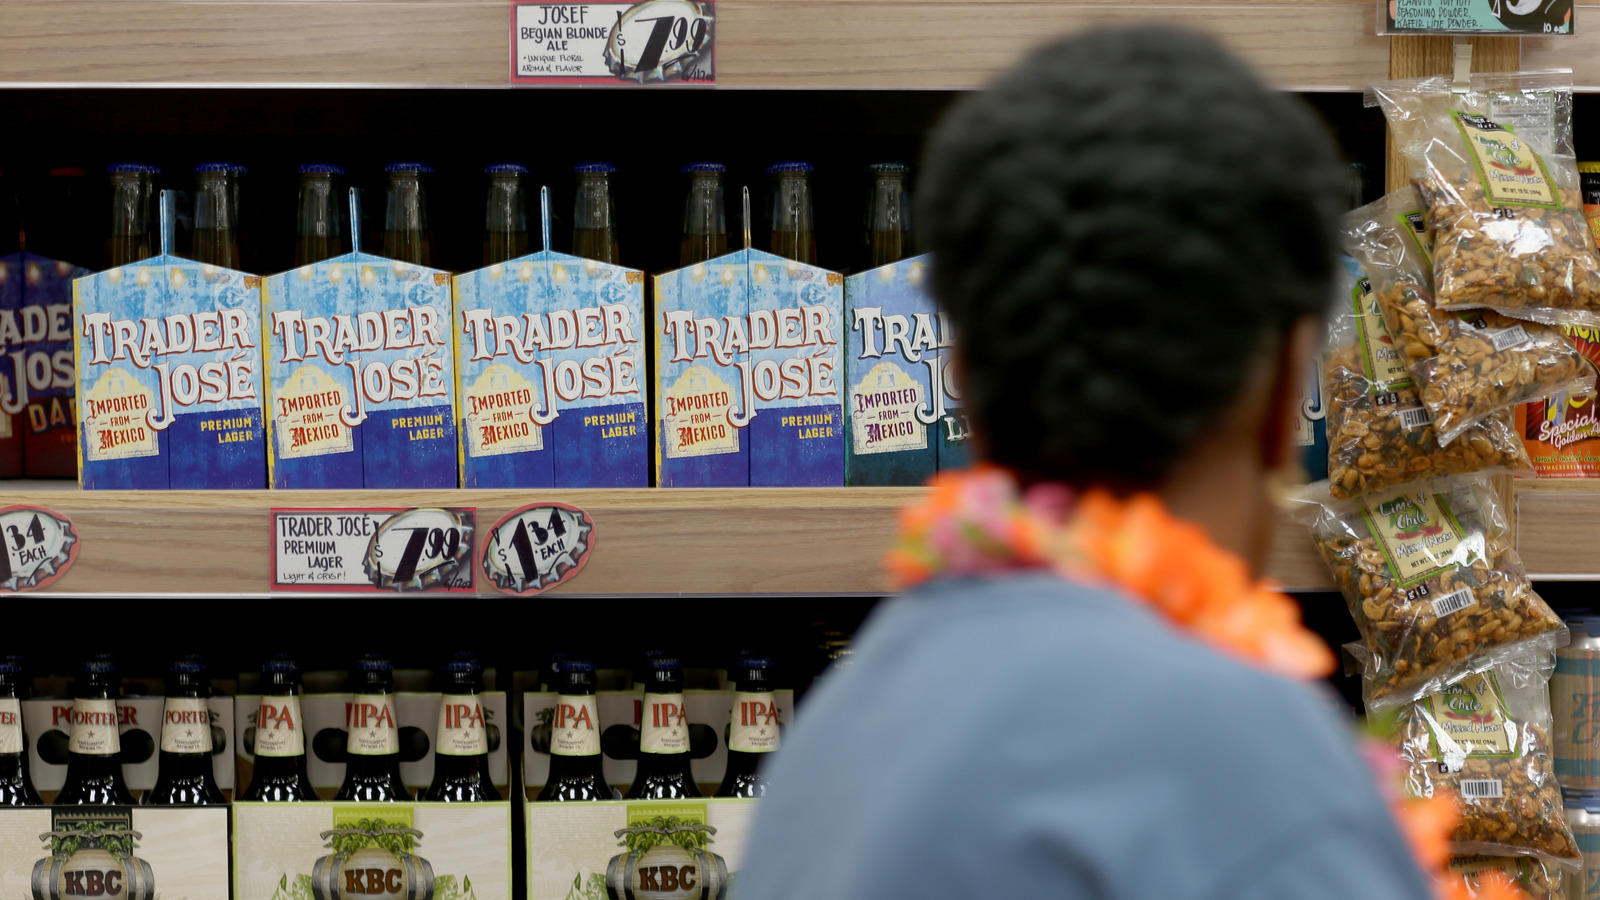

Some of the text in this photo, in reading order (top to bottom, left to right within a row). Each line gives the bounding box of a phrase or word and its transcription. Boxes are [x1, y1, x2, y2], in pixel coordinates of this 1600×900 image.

[538, 6, 589, 25] JOSEF
[1396, 7, 1435, 19] SEASONING
[566, 27, 608, 40] BLONDE
[1542, 23, 1552, 33] 10
[547, 41, 568, 51] ALE
[1476, 134, 1507, 151] Lime
[0, 303, 73, 355] ADE
[82, 308, 256, 369] TRADER
[271, 305, 447, 366] TRADER
[462, 303, 640, 365] TRADER
[663, 305, 838, 367] TRADER
[852, 305, 957, 363] TRA
[1, 349, 75, 416] JOS
[145, 350, 257, 432] JOSÉ
[339, 347, 448, 428] JOSÉ
[529, 345, 640, 426] JOSÉ
[727, 346, 838, 430] JOSÉ
[914, 355, 963, 425] JO
[86, 394, 148, 421] IMPORTED
[277, 391, 342, 418] IMPORTED
[467, 389, 532, 416] IMPORTED
[665, 391, 729, 418] IMPORTED
[853, 388, 918, 415] IMPORTED
[29, 397, 77, 432] DA
[110, 415, 132, 428] FROM
[200, 418, 252, 432] PREMIUM
[302, 412, 325, 425] FROM
[391, 415, 444, 430] PREMIUM
[492, 412, 515, 424] FROM
[584, 413, 637, 427] PREMIUM
[691, 413, 712, 425] FROM
[781, 414, 834, 427] PREMIUM
[878, 411, 900, 423] FROM
[1538, 404, 1597, 446] Special
[98, 427, 146, 452] MEXICO
[218, 431, 254, 444] LAGER
[289, 423, 341, 450] MEXICO
[409, 428, 445, 441] LAGER
[480, 422, 530, 448] MEXICO
[601, 426, 638, 439] LAGER
[678, 424, 727, 450] MEXICO
[799, 427, 834, 440] LAGER
[864, 420, 915, 447] MEXICO
[1555, 428, 1588, 451] Golden
[1379, 499, 1413, 517] Lime
[1396, 510, 1428, 529] Chile
[278, 513, 371, 538] TRADER JOSÉ
[19, 545, 46, 566] EACH
[284, 540, 336, 555] PREMIUM
[540, 538, 565, 561] EACH
[1395, 537, 1428, 560] Mixed
[1428, 531, 1454, 547] Nuts
[308, 572, 315, 581] &
[317, 572, 346, 580] CRISP!
[652, 702, 688, 727] IPA
[741, 701, 779, 727] IPA
[1448, 696, 1481, 711] Chile
[72, 710, 116, 726] PORTER
[257, 704, 296, 730] IPA
[354, 704, 394, 729] IPA
[446, 704, 486, 729] IPA
[554, 703, 594, 730] IPA
[1441, 720, 1502, 734] Mixed Nuts
[64, 870, 122, 896] KBC
[344, 868, 403, 894] KBC
[638, 865, 696, 892] KBC
